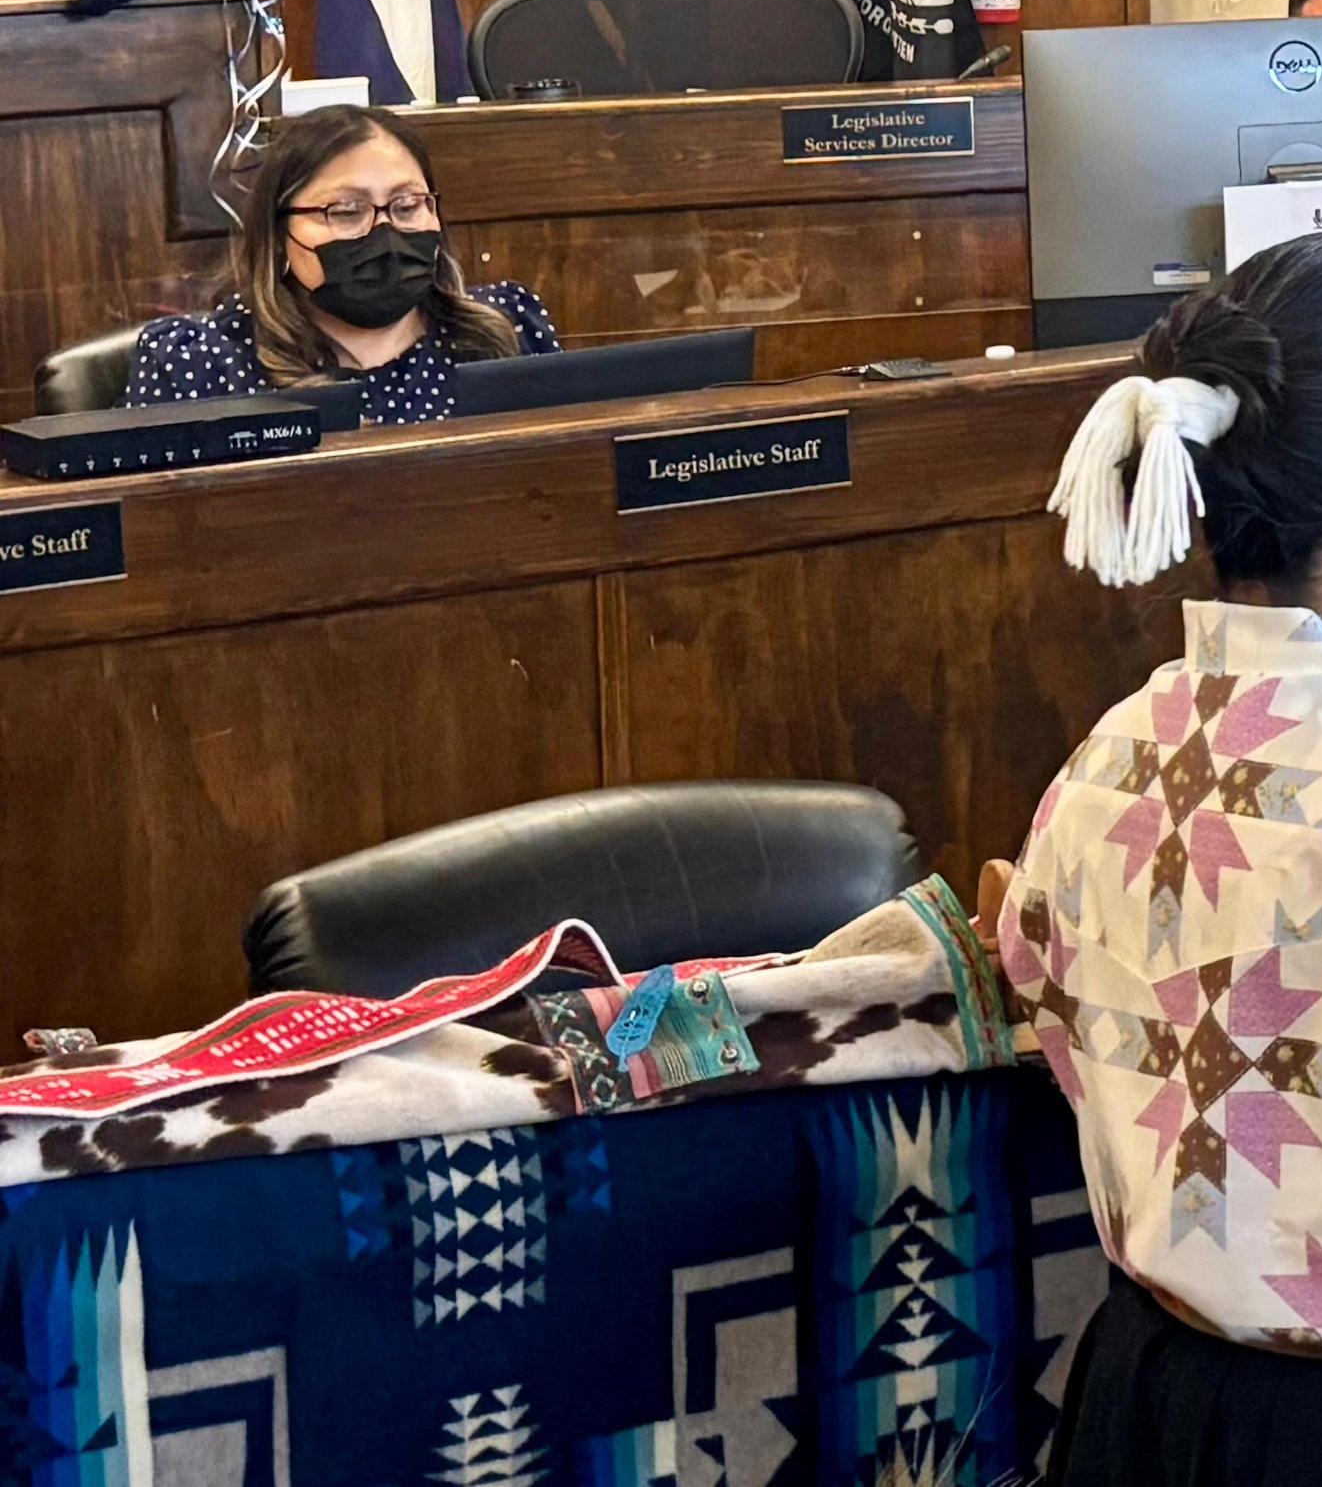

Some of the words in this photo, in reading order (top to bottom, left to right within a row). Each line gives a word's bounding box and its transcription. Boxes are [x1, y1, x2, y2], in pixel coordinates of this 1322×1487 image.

[831, 110, 926, 132] Legislative
[804, 134, 876, 153] Services
[881, 132, 955, 149] Director
[262, 425, 302, 441] MX6/4
[648, 449, 766, 482] Legislative
[770, 438, 822, 464] Staff
[31, 527, 92, 557] Staff
